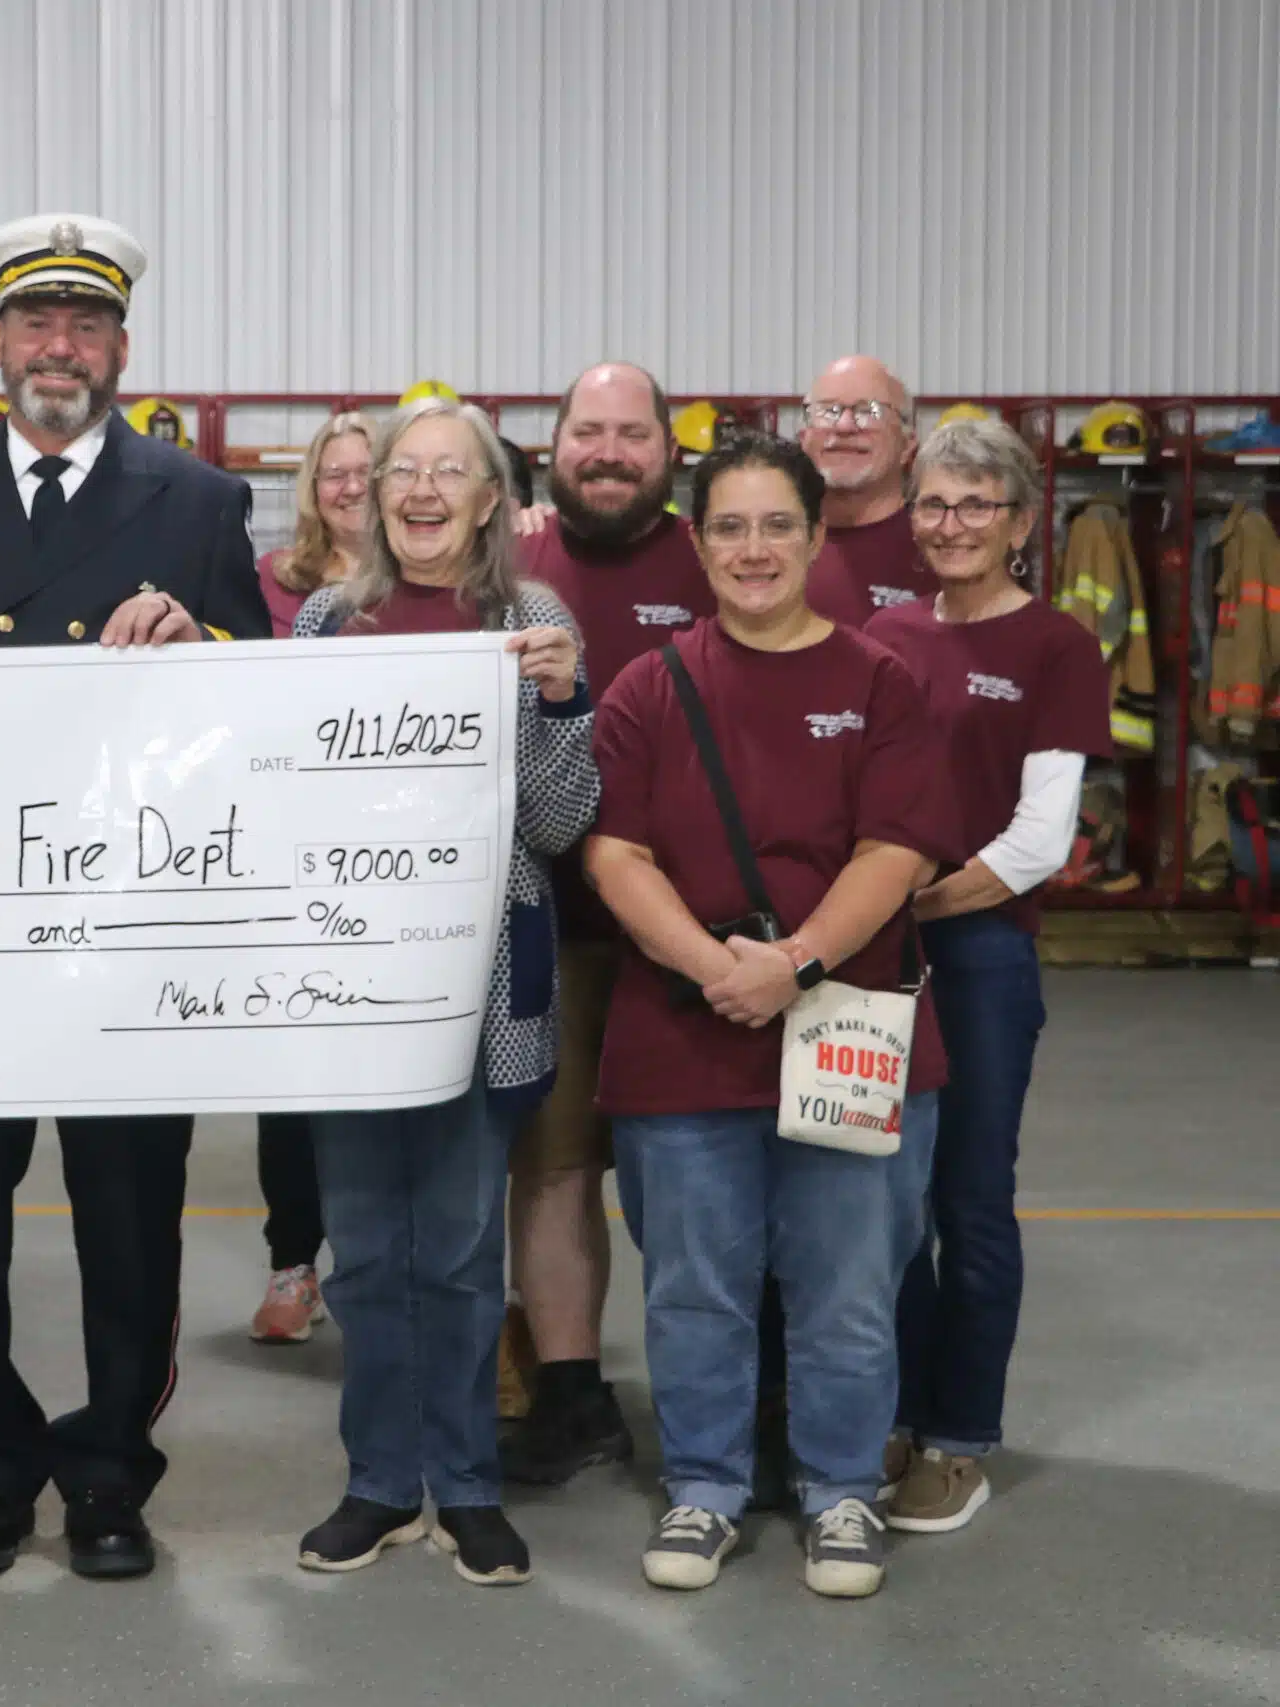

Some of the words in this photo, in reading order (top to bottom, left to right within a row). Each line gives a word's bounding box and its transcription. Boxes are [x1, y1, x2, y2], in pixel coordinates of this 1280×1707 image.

[317, 702, 481, 761] 9/11/2025
[250, 757, 294, 773] DATE
[19, 801, 107, 888] Fire
[138, 803, 256, 885] Dept.
[303, 852, 316, 874] $
[27, 917, 92, 945] and
[400, 924, 477, 942] DOLLARS
[817, 1041, 900, 1085] HOUSE
[851, 1084, 868, 1098] ON
[798, 1094, 844, 1126] YOU
